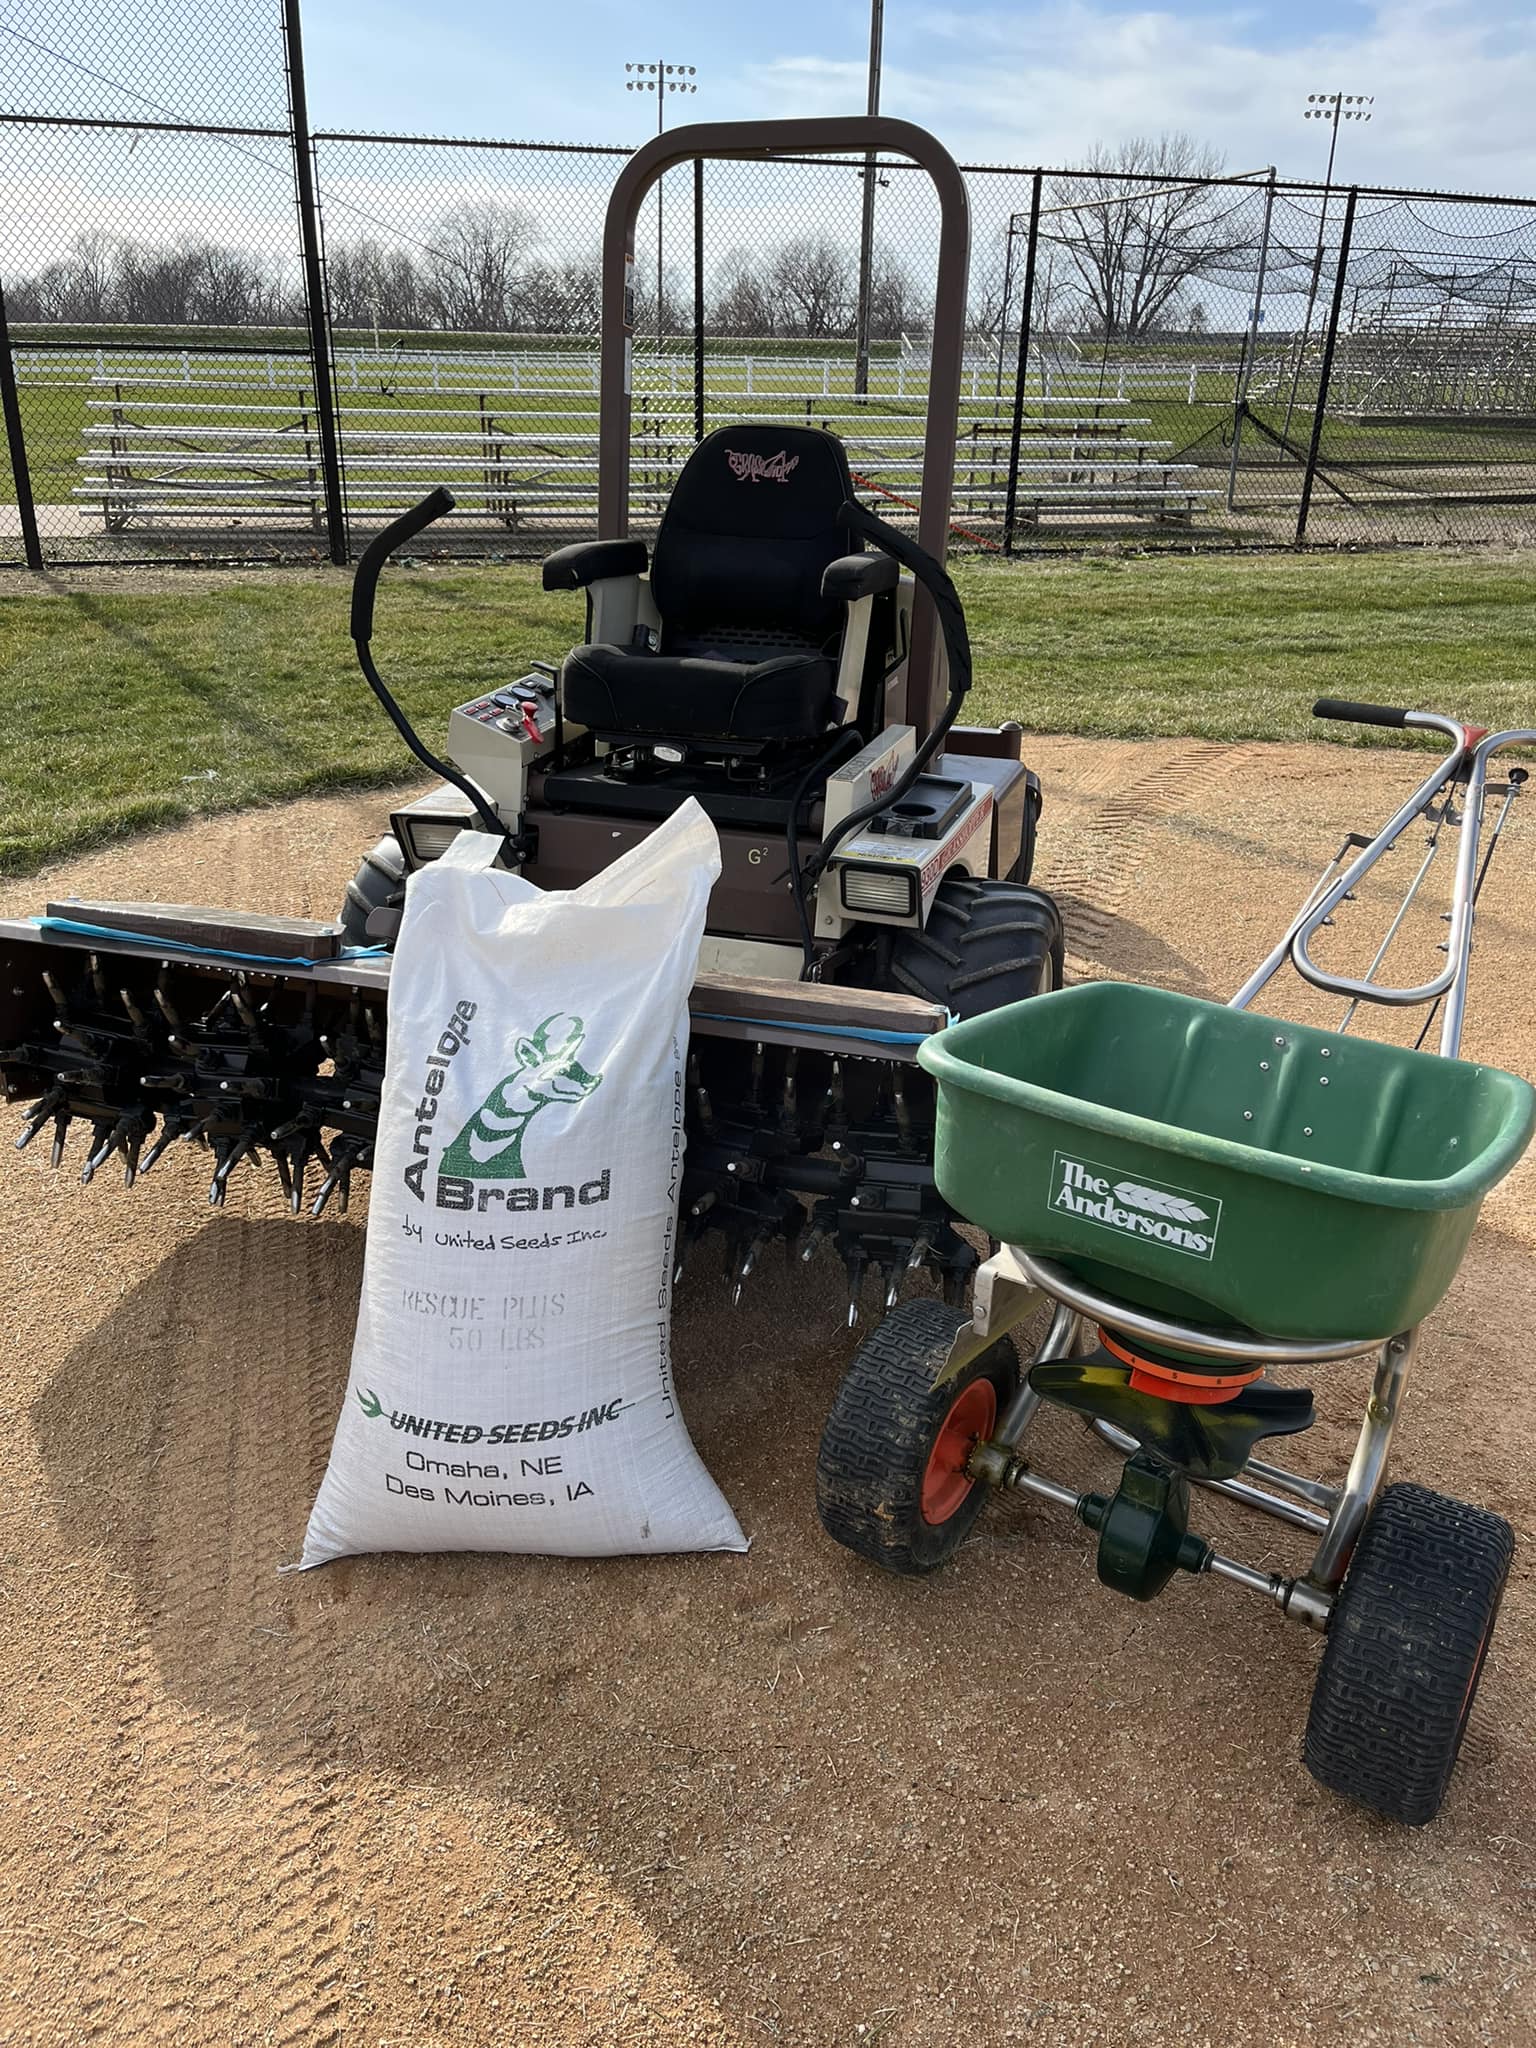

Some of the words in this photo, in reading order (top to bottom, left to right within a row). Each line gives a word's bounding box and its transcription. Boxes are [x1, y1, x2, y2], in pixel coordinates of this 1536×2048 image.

[403, 999, 479, 1204] Antelope
[667, 1070, 682, 1203] Antelope
[435, 1168, 611, 1213] Brand
[1060, 1159, 1110, 1196] The
[402, 1214, 423, 1243] by
[434, 1230, 496, 1251] United
[500, 1233, 562, 1250] Seeds
[1054, 1185, 1209, 1253] Andersons
[658, 1216, 673, 1310] Seeds
[402, 1289, 486, 1320] RESCUE
[503, 1293, 566, 1320] PLUS
[450, 1326, 482, 1351] 50
[501, 1327, 545, 1350] LBS
[657, 1322, 675, 1420] United
[390, 1410, 484, 1444] UNITED
[487, 1415, 576, 1445] SEEDS
[577, 1398, 623, 1433] INC
[406, 1451, 508, 1480] Omaha,
[520, 1455, 563, 1477] NE
[386, 1473, 435, 1502] Des
[445, 1487, 555, 1507] Moines,
[566, 1481, 594, 1502] IA
